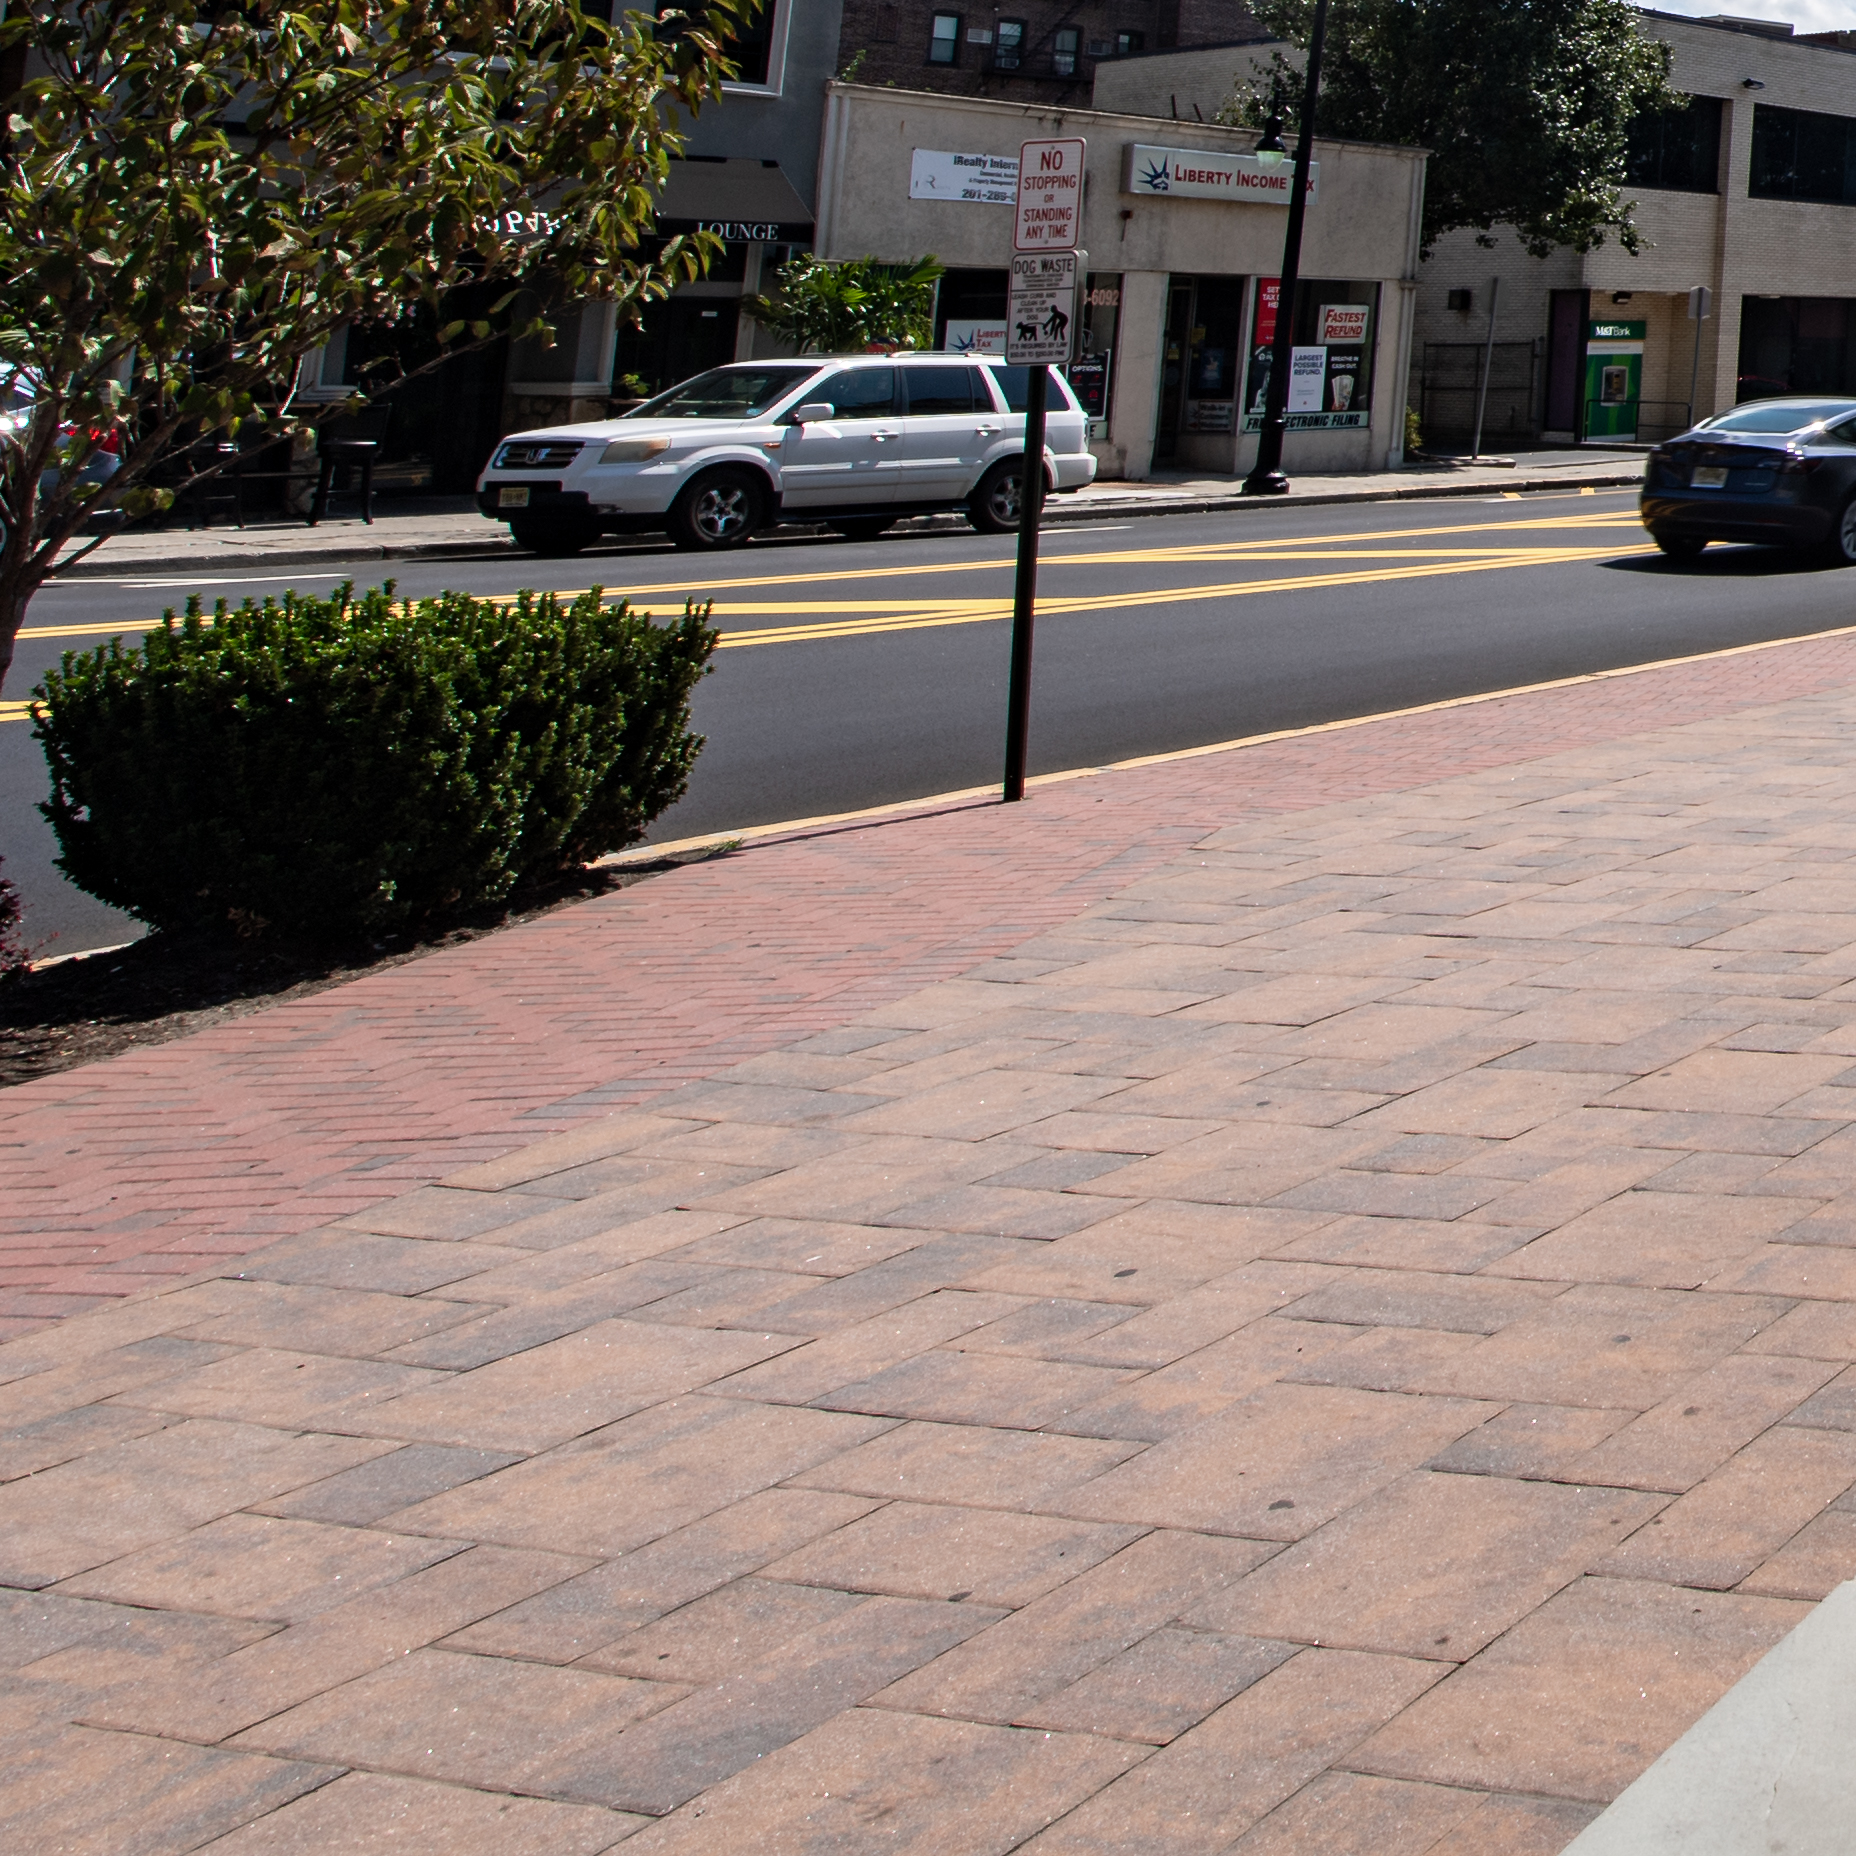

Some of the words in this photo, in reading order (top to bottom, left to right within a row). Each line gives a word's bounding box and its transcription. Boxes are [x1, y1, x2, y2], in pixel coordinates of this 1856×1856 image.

[1040, 150, 1063, 171] NO
[1024, 174, 1076, 190] STOPPING
[1174, 164, 1233, 186] LIBERTY
[1236, 169, 1287, 190] INCOME
[1043, 194, 1054, 203] OR
[1023, 207, 1073, 222] STANDING
[1025, 225, 1044, 239] ANY
[1047, 224, 1068, 238] TIME
[1014, 260, 1036, 274] DOG
[1041, 258, 1073, 273] WASTE
[1324, 309, 1367, 324] FASTEST
[1324, 325, 1363, 339] REFUND
[1613, 326, 1631, 336] Bank
[977, 339, 992, 348] TAX
[1293, 361, 1323, 369] POSSIBLE
[1332, 414, 1360, 426] FILING
